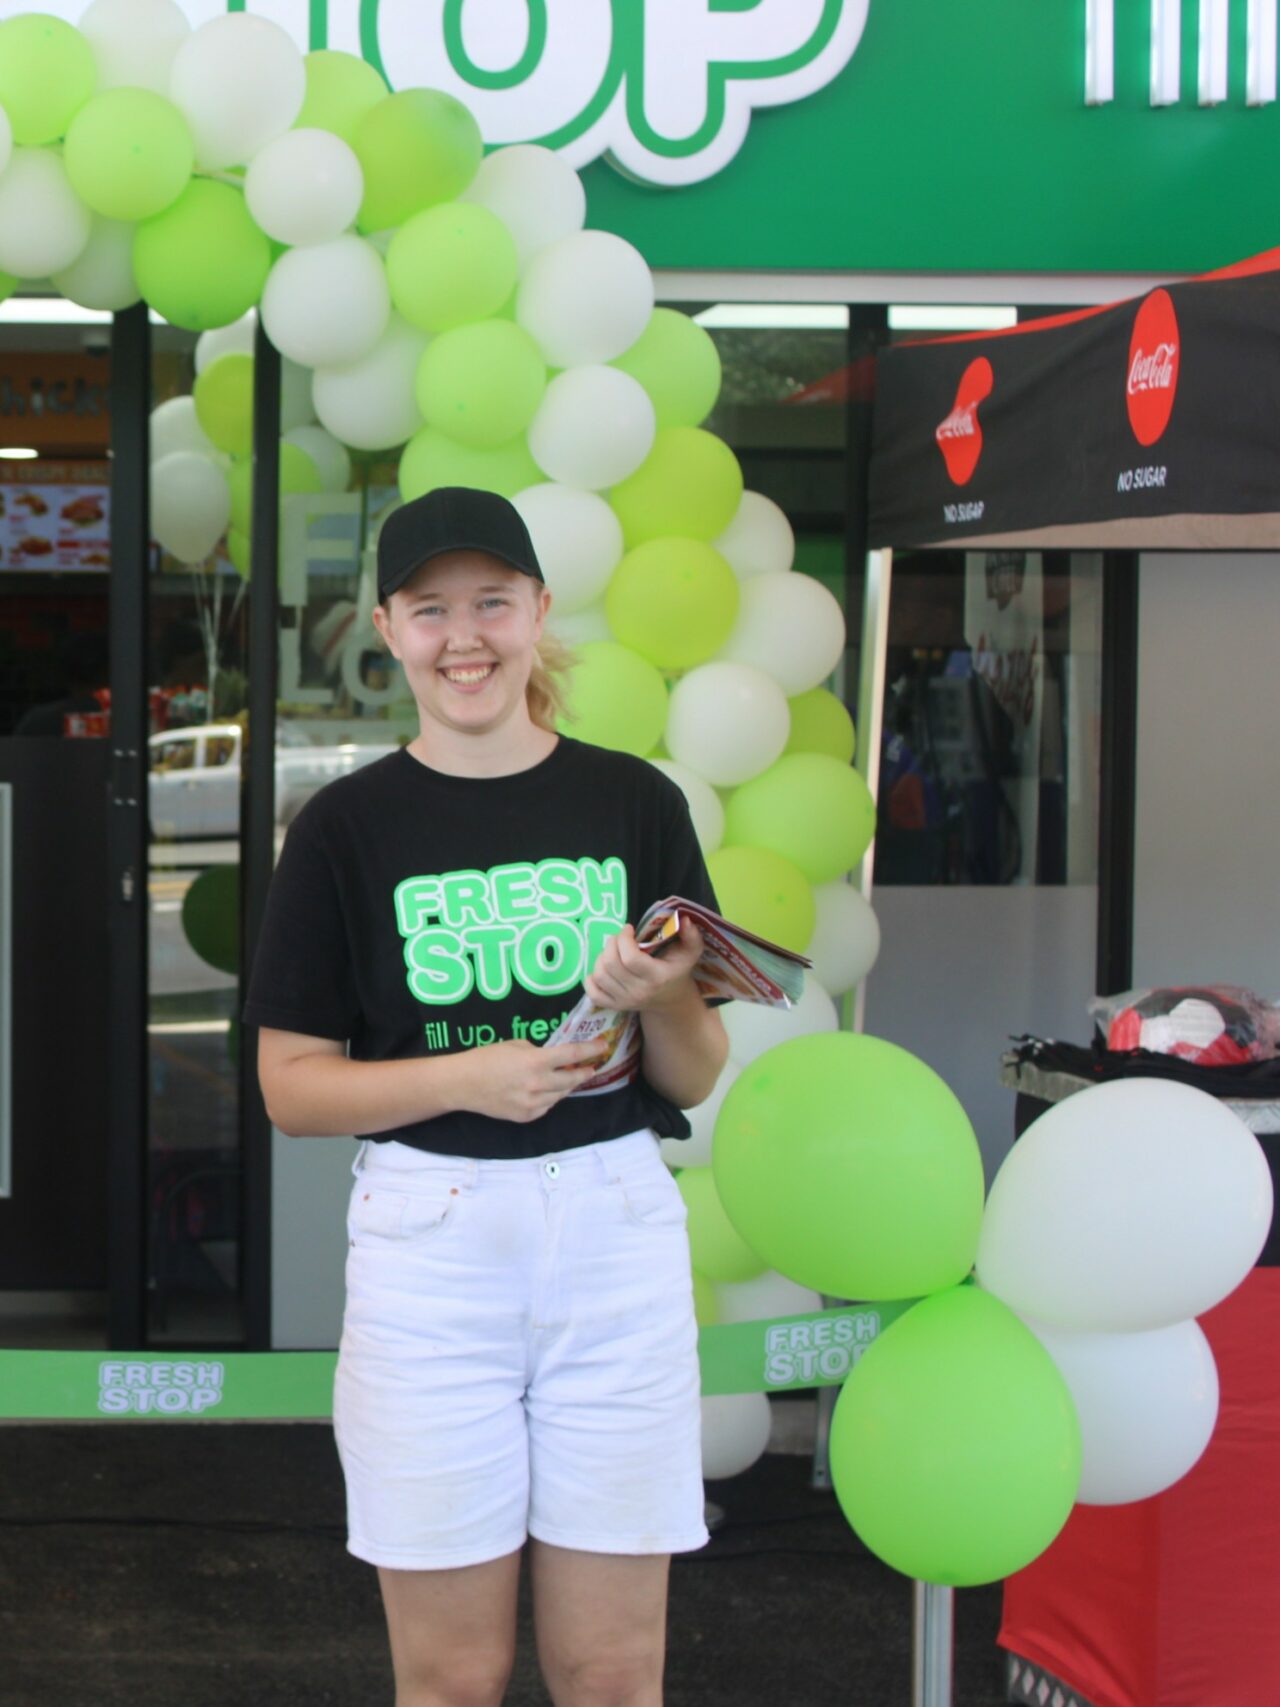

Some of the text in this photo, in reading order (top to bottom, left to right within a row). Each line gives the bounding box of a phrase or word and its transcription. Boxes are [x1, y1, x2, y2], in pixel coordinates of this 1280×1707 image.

[1117, 465, 1167, 492] NO SUGAR
[943, 504, 958, 522] NO
[395, 857, 627, 937] FRESH
[425, 1021, 450, 1050] fill
[511, 1011, 570, 1043] fres
[765, 1311, 881, 1351] FRESH
[99, 1361, 224, 1388] FRESH
[98, 1385, 223, 1414] STOP
